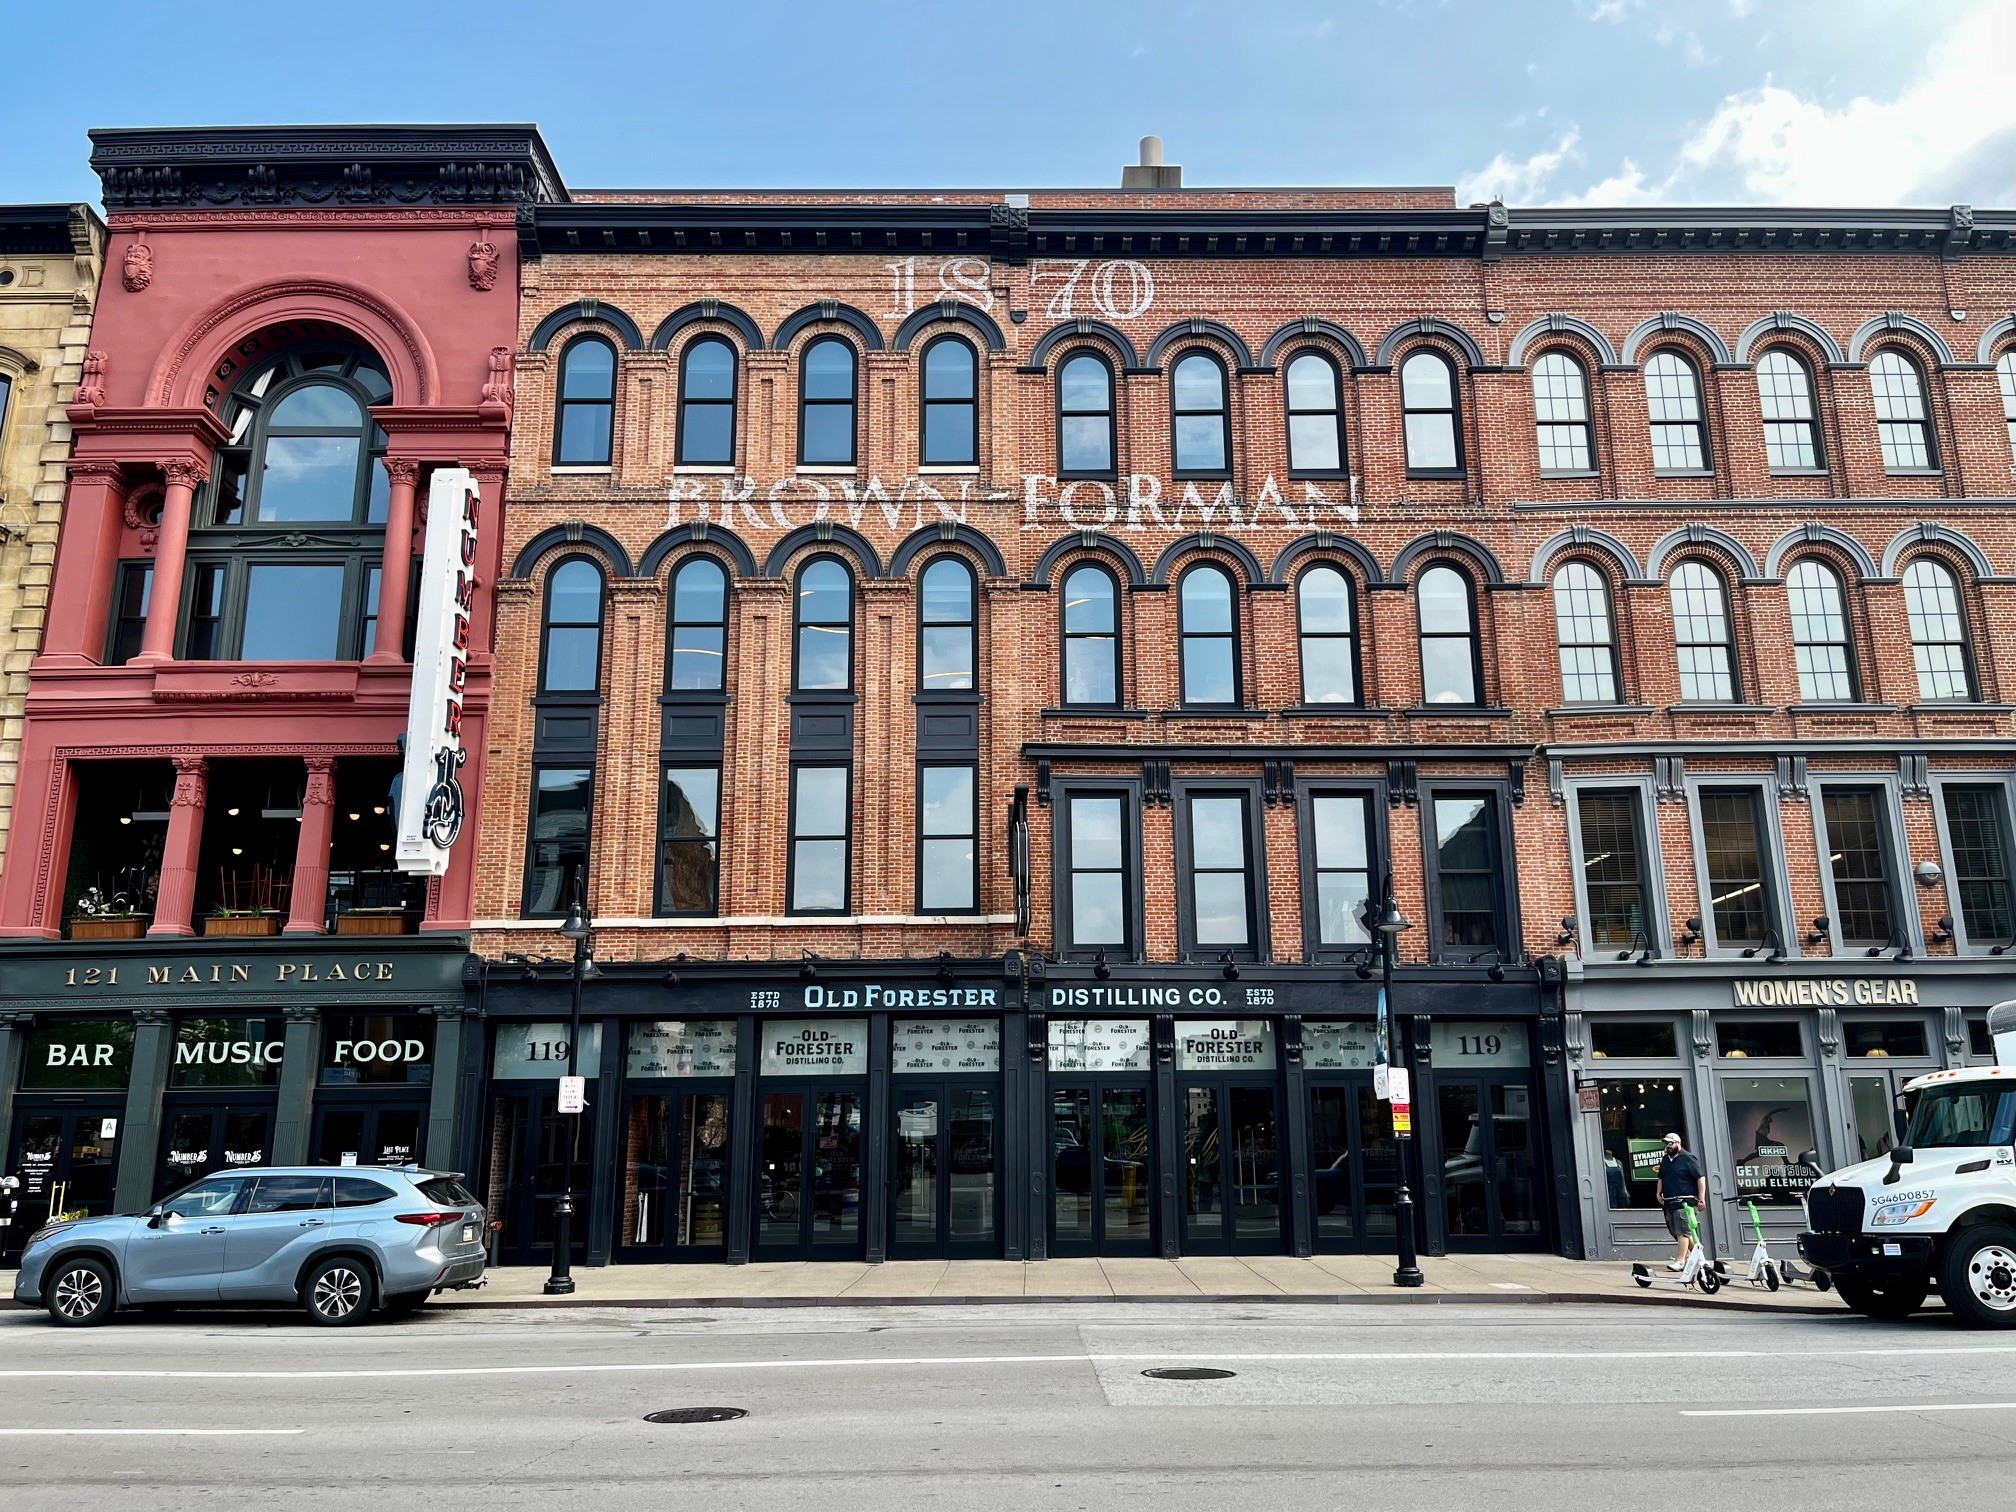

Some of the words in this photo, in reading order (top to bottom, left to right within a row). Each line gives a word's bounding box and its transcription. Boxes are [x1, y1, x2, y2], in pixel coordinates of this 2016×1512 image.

[446, 488, 481, 738] NUMBER
[65, 967, 118, 986] 121
[146, 964, 252, 984] MAIN
[275, 962, 393, 981] PLACE
[750, 991, 780, 1000] ESTD
[804, 985, 858, 1008] OLD
[864, 984, 997, 1008] FORESTER
[1052, 988, 1180, 1006] DISTILLING
[1188, 988, 1227, 1006] CO.
[1245, 988, 1274, 996] ESTD
[1733, 979, 1850, 1006] WOMEN'S
[1853, 979, 1919, 1005] GEAR
[750, 1000, 780, 1009] 1870
[1246, 996, 1274, 1005] 1870
[801, 1029, 829, 1042] OLD
[1210, 1028, 1238, 1040] OLD
[333, 1039, 425, 1063] FOOD
[526, 1041, 570, 1061] 119
[776, 1041, 854, 1056] FORESTER
[1186, 1039, 1263, 1054] FORESTER
[1457, 1034, 1501, 1055] 119
[46, 1043, 114, 1067] BAR
[175, 1041, 284, 1065] MUSIC
[786, 1057, 829, 1065] DISTILLING
[832, 1056, 844, 1065] CO.
[1197, 1055, 1240, 1063] DISTILLING
[1242, 1055, 1255, 1063] CO.
[105, 1122, 113, 1131] A
[1736, 1165, 1759, 1177] GET
[1737, 1178, 1767, 1188] YOUR
[1871, 1189, 1935, 1206] SG46D0857
